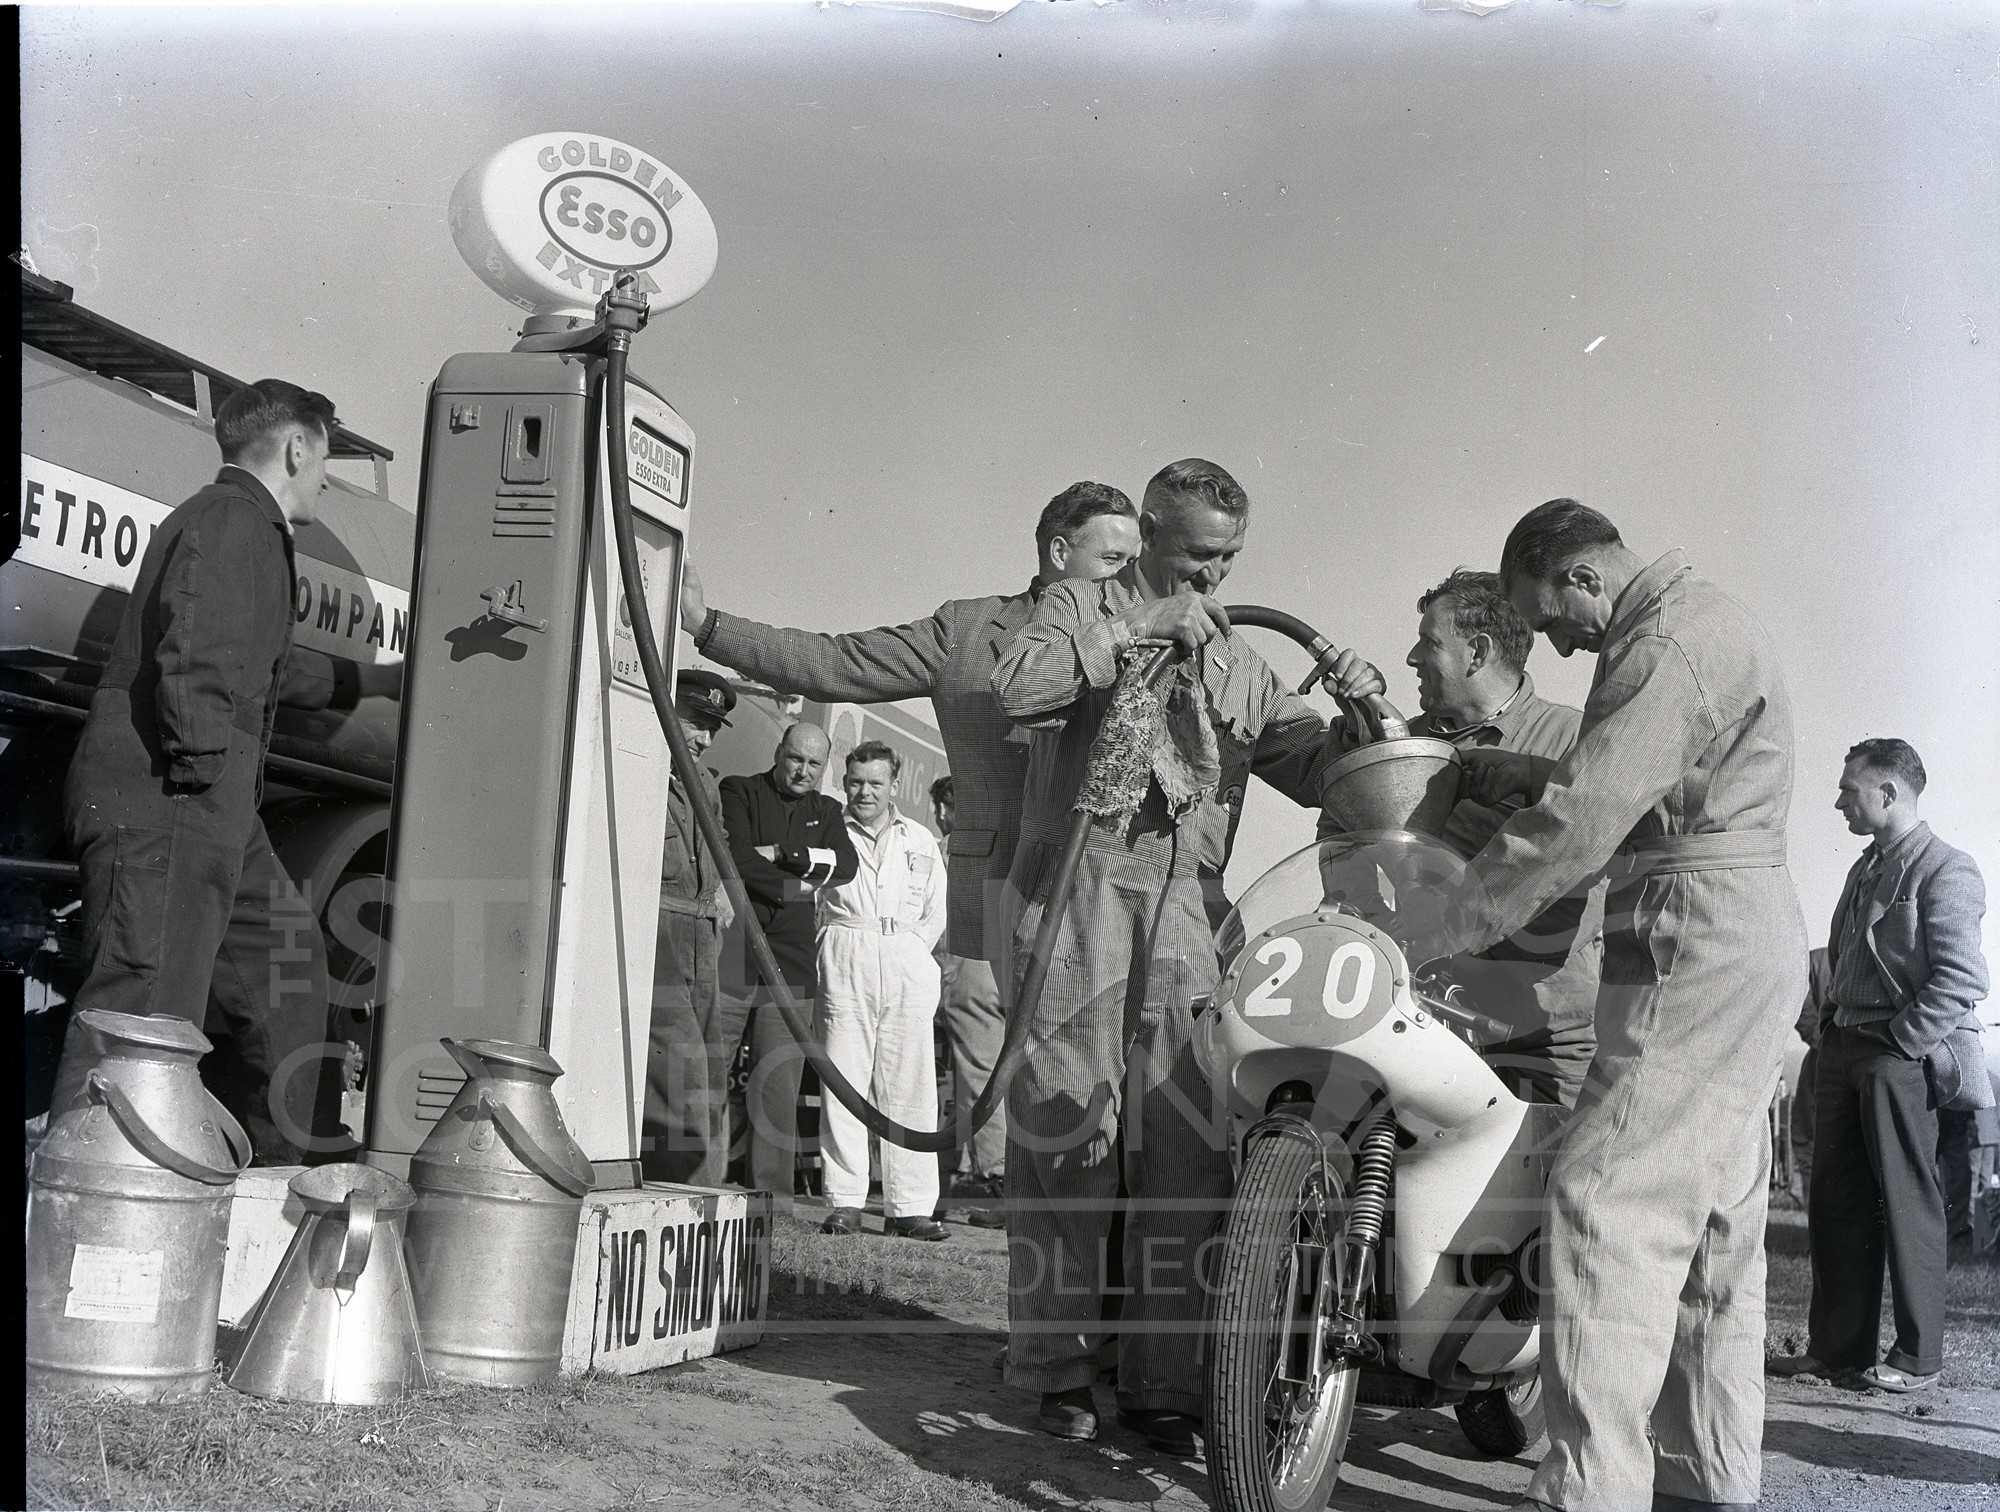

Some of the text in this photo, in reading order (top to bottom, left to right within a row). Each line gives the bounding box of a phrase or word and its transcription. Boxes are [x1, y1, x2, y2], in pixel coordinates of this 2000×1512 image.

[538, 140, 683, 211] GOLDEN
[536, 241, 662, 297] EXTA
[629, 430, 681, 479] GOLDEN
[635, 461, 671, 494] ESSO EXTRA
[21, 480, 158, 568] ETRO
[1244, 937, 1376, 1019] 20
[604, 1216, 765, 1353] NO SMOKING
